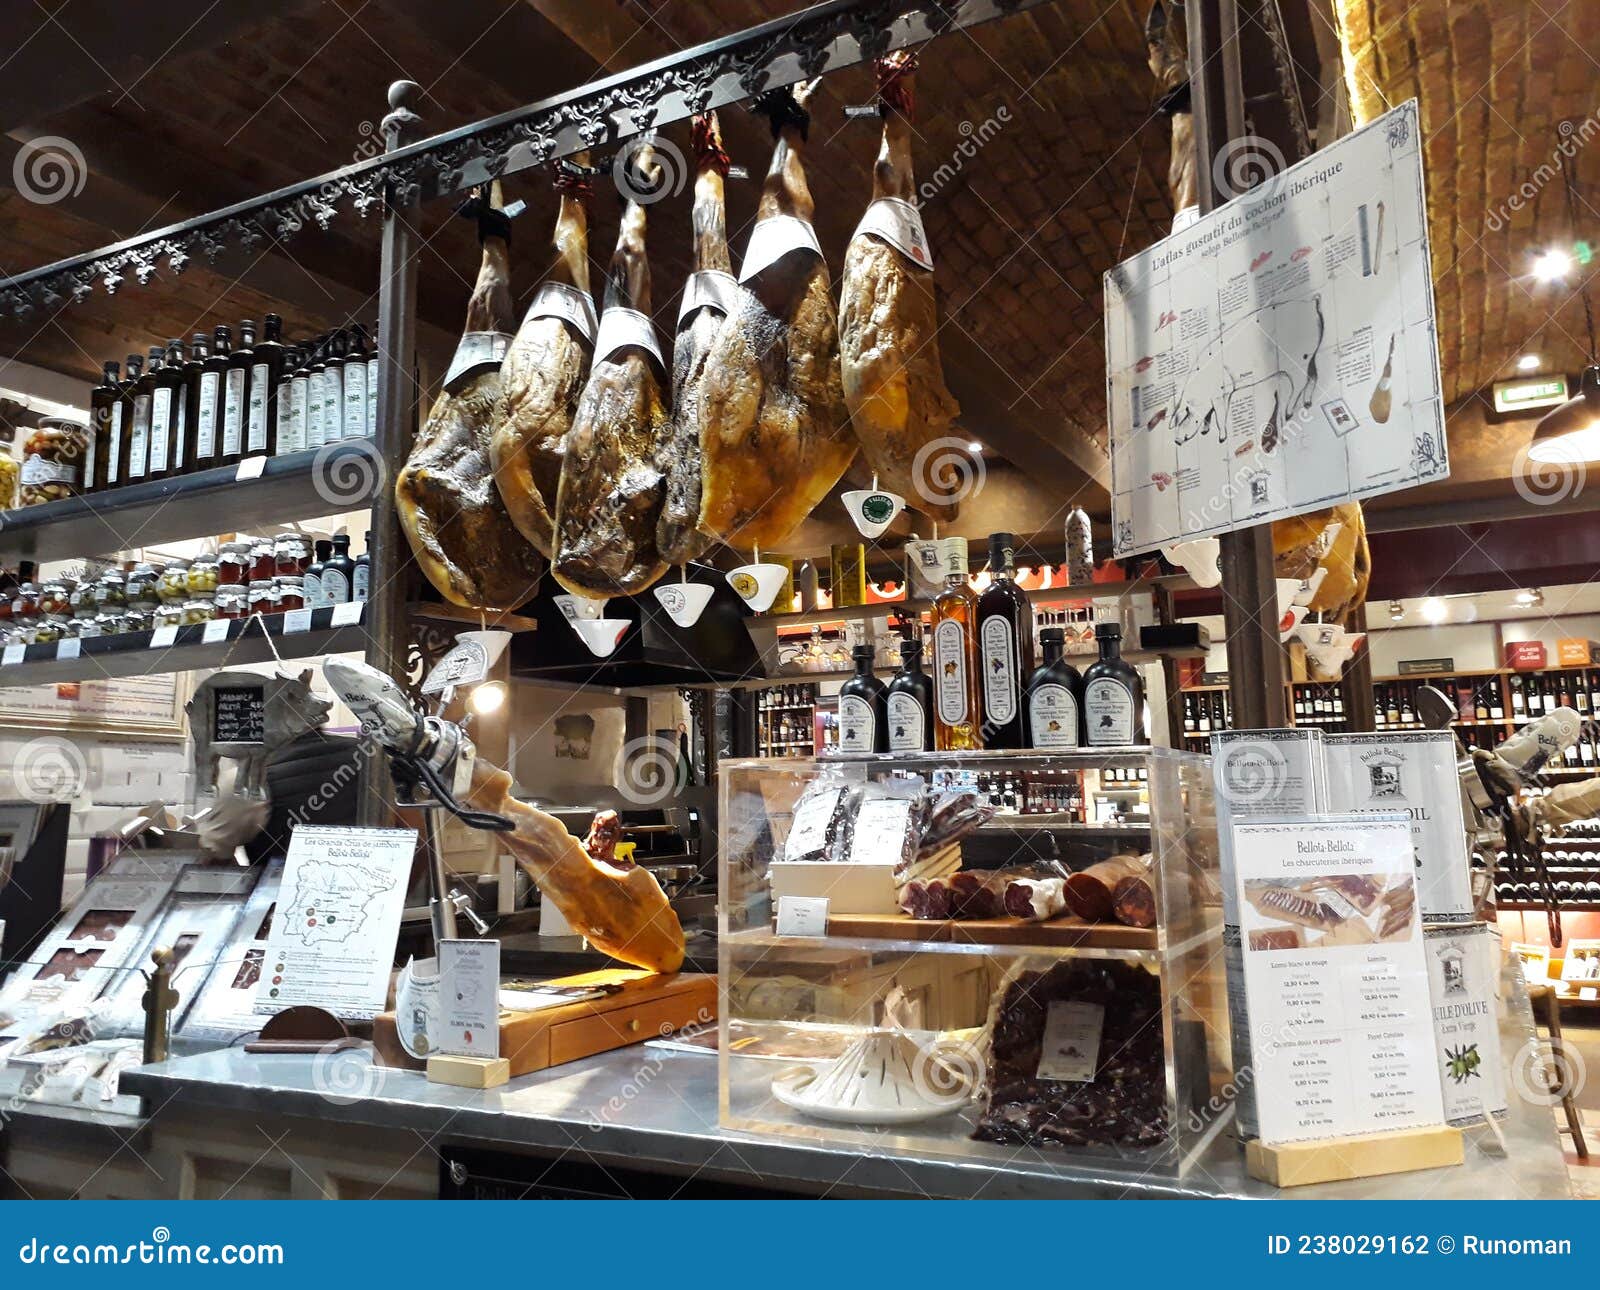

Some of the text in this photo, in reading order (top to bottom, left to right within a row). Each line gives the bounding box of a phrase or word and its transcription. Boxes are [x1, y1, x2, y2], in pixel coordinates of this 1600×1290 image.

[1186, 222, 1226, 255] gustatif
[1228, 215, 1242, 230] du
[1244, 192, 1287, 221] cochon
[1290, 161, 1344, 198] ibérique
[1282, 859, 1295, 867] Les
[1296, 858, 1340, 867] charcuteries
